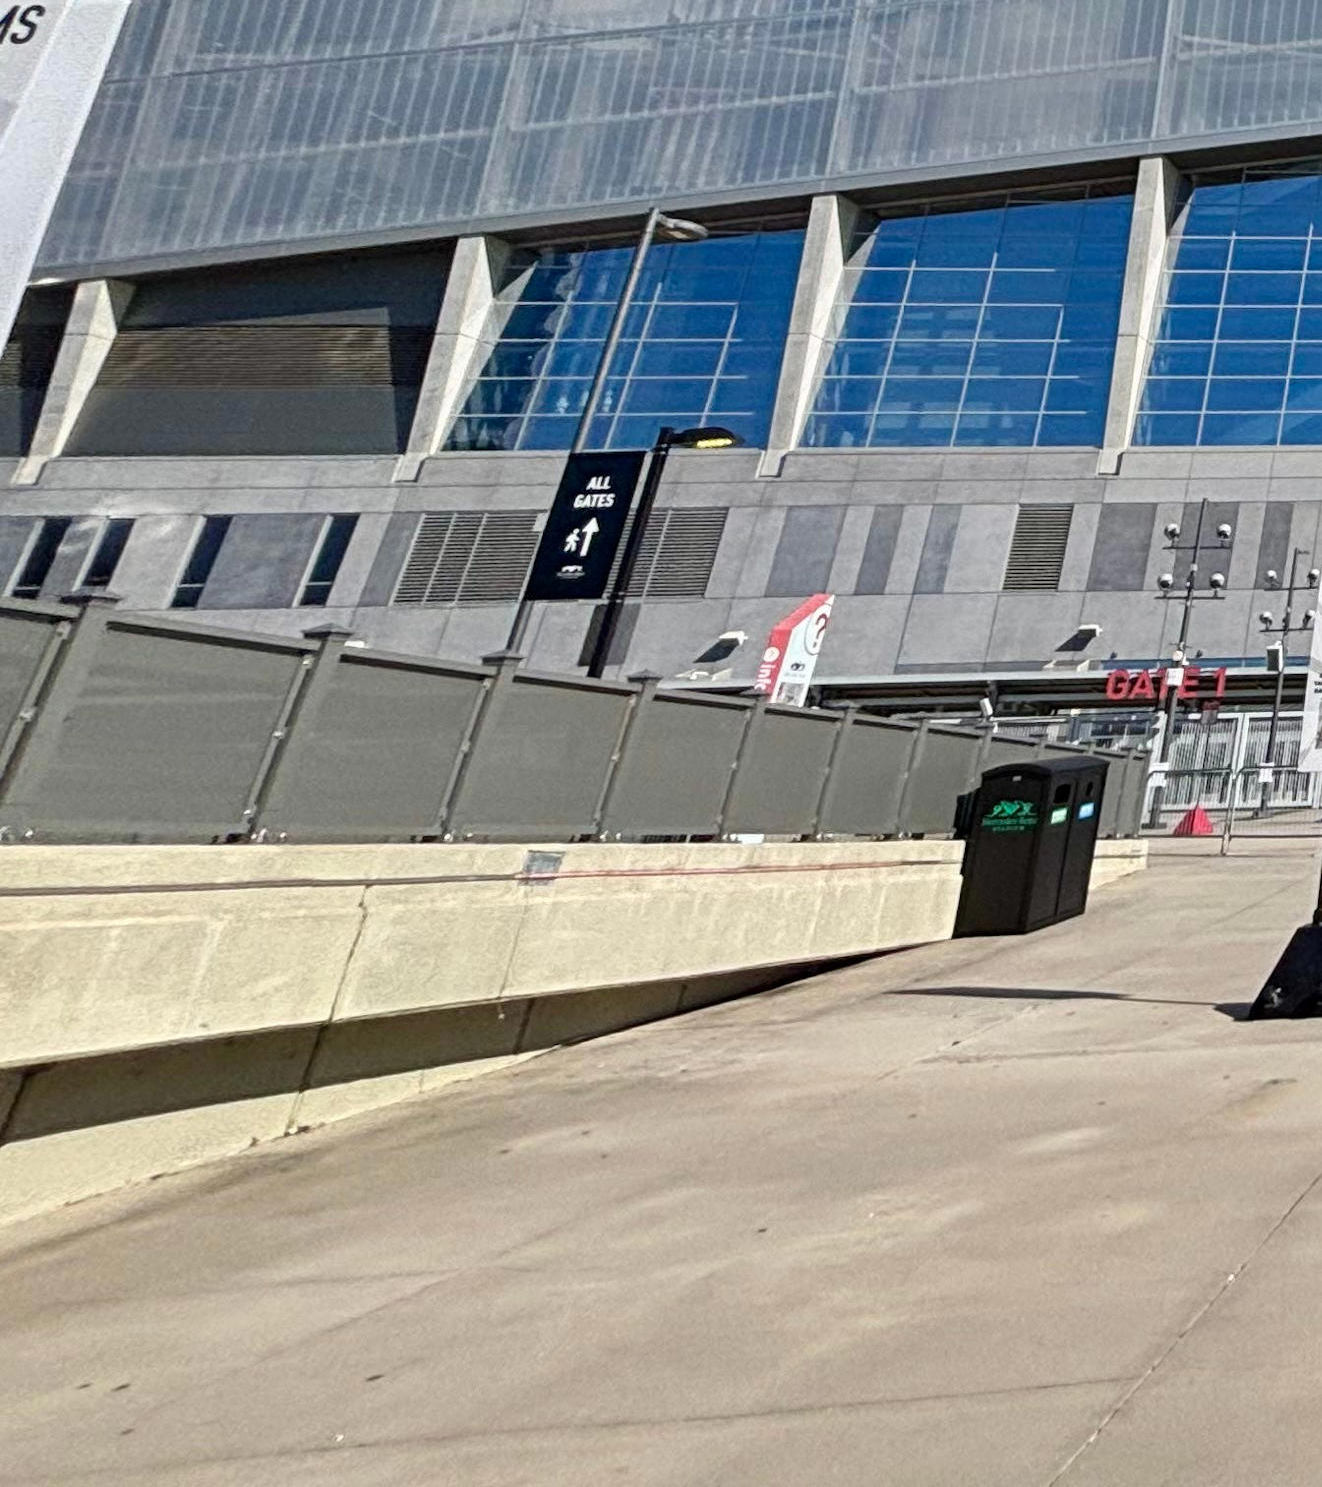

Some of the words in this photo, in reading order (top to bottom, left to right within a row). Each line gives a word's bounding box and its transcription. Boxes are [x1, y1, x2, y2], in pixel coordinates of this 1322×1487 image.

[586, 476, 611, 491] ALL
[573, 493, 616, 508] GATES
[1213, 668, 1227, 698] 1
